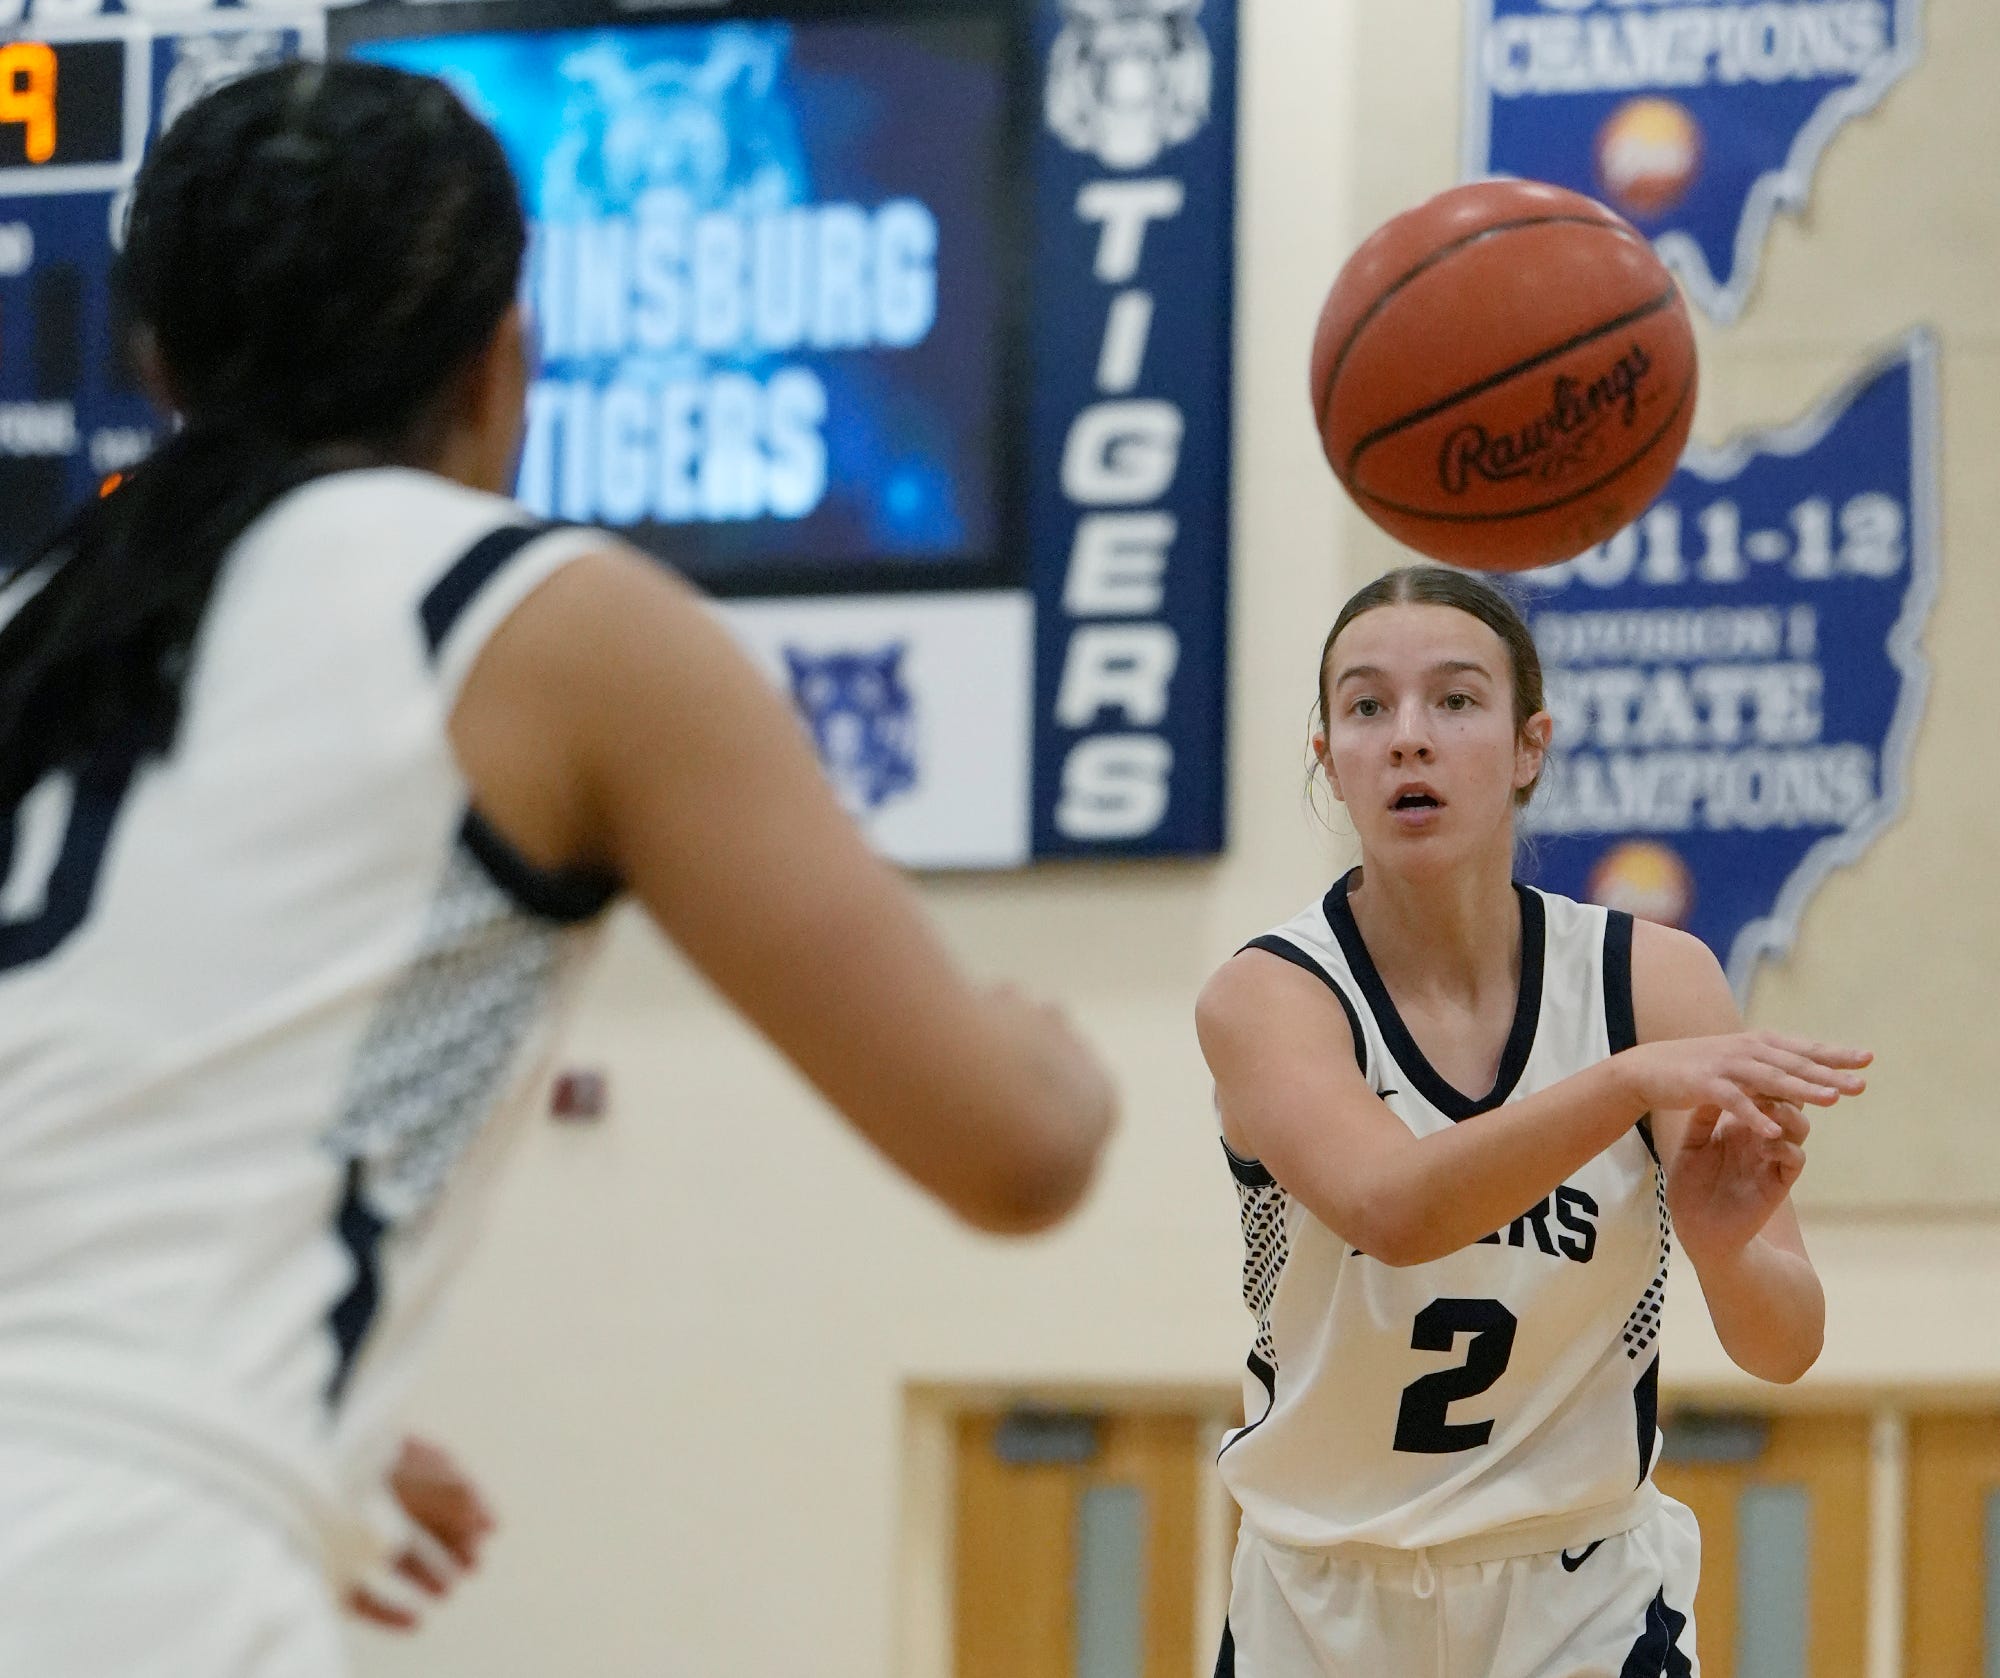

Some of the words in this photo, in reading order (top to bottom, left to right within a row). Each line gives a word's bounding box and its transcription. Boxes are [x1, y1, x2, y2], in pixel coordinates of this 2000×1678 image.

[0, 41, 57, 164] 9
[1484, 6, 1886, 94] CHAMPIONS
[526, 195, 939, 359] INSBURG
[516, 366, 828, 524] TIGERS
[1438, 343, 1653, 496] Rawlings
[1053, 177, 1186, 841] TIGERS
[1522, 492, 1903, 589] 11-12
[1393, 1298, 1517, 1454] 2
